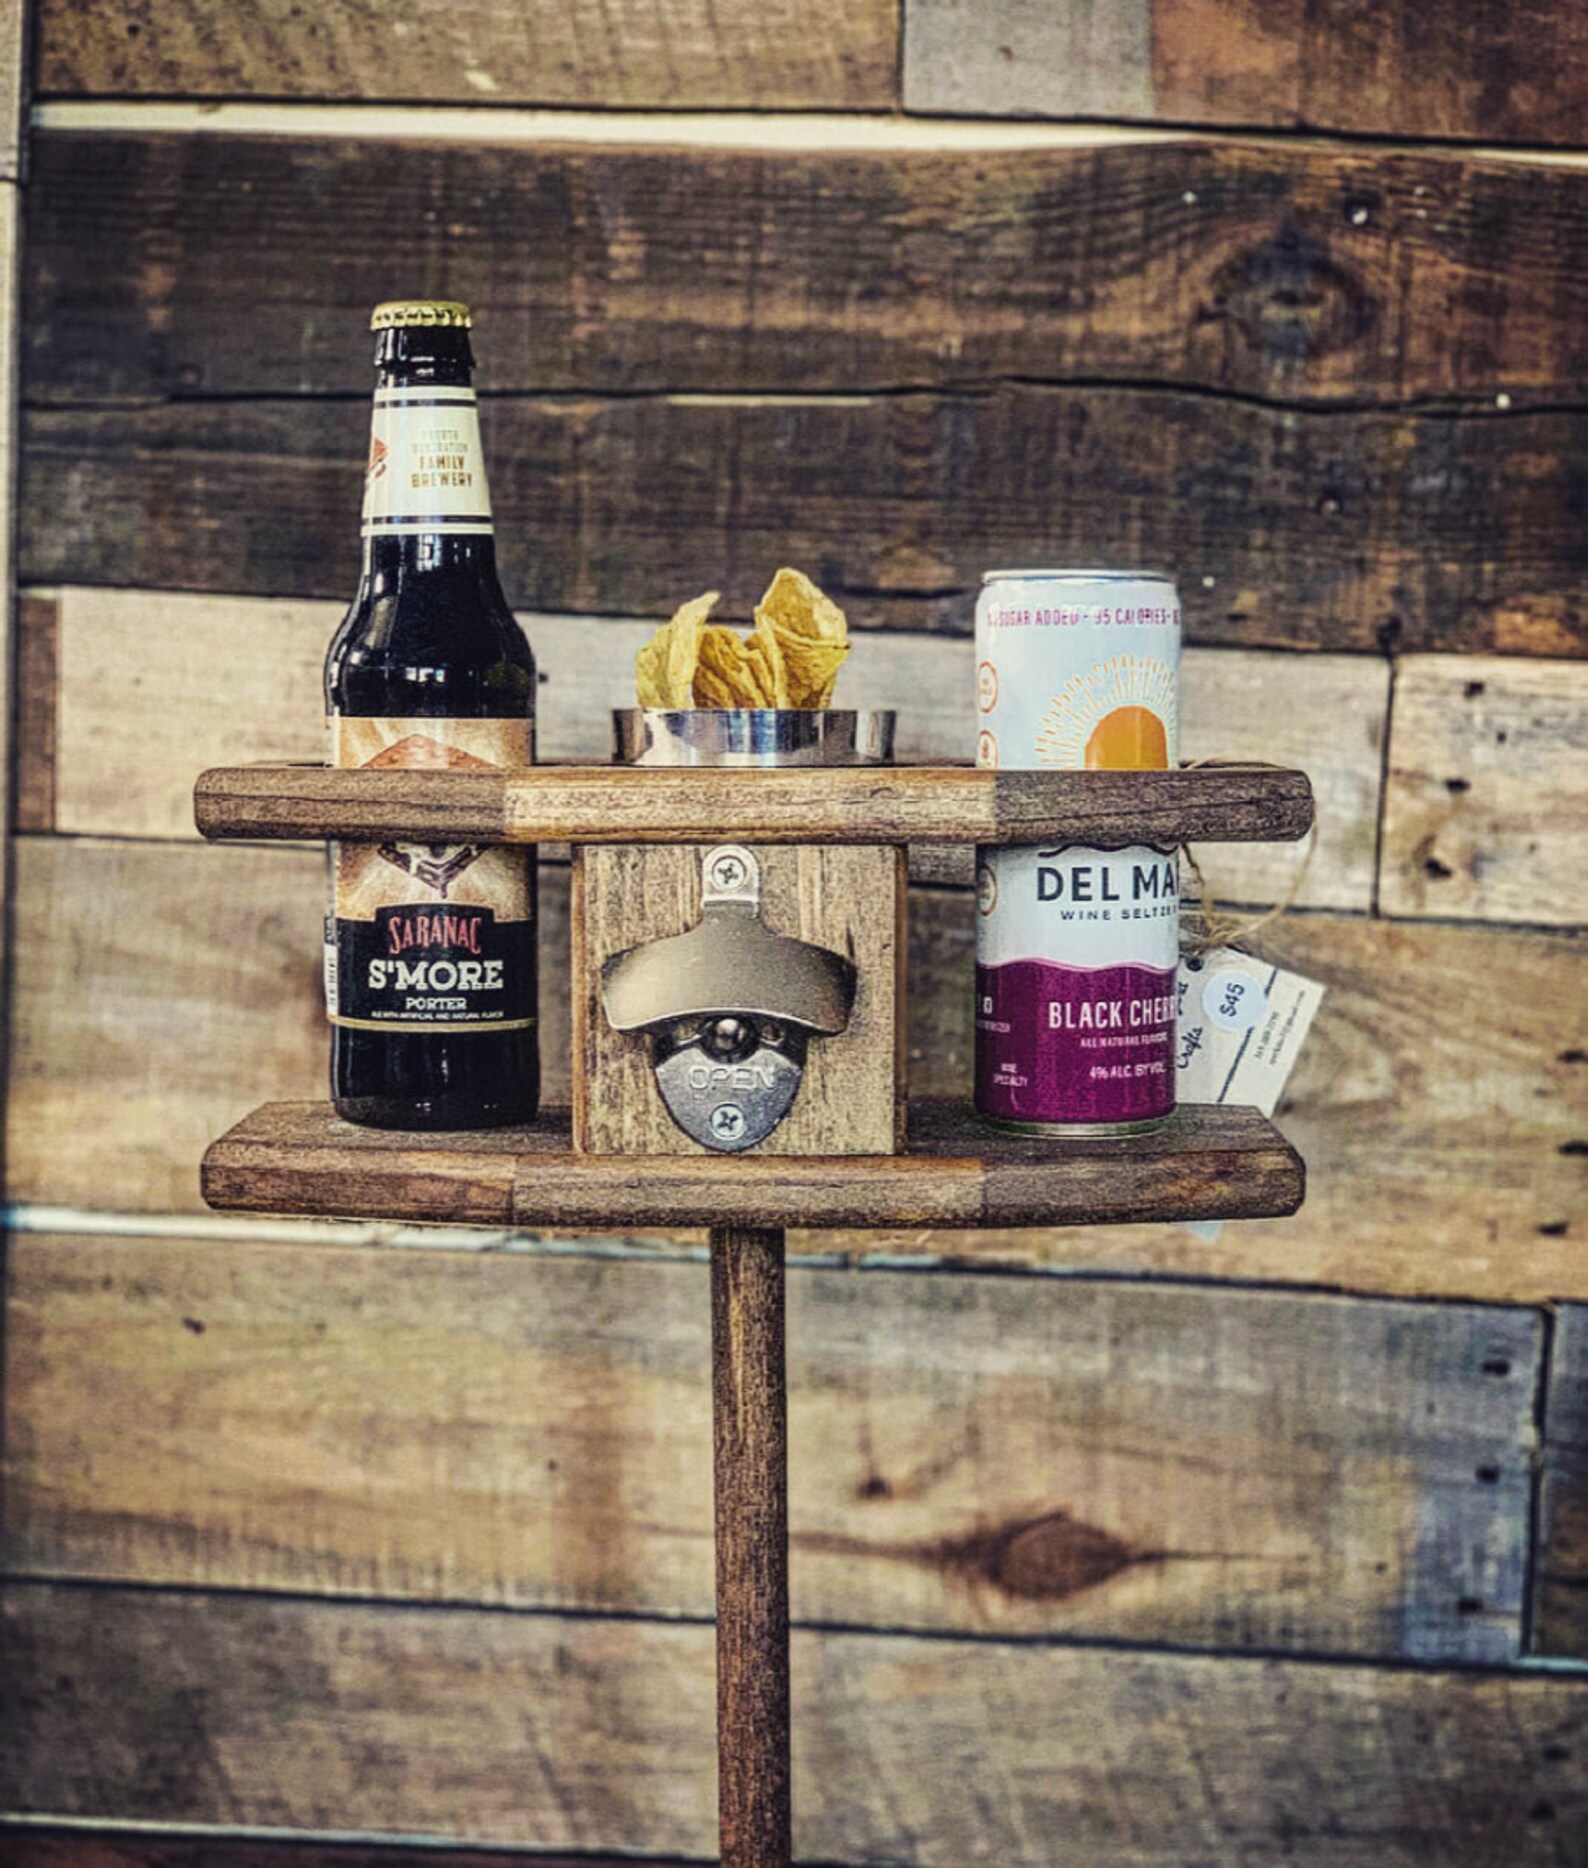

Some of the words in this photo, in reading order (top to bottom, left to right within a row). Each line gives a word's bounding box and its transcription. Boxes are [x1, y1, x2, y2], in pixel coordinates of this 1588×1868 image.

[419, 455, 465, 469] FAMILY
[411, 472, 473, 488] BREWERY
[1037, 866, 1120, 901] DEL
[1132, 862, 1180, 900] MA
[1060, 908, 1112, 921] WINE
[388, 914, 482, 954] SARANAC
[368, 957, 504, 990] S'MORE
[405, 997, 467, 1010] PORTER
[1048, 1001, 1123, 1029] BLACK
[1080, 1037, 1097, 1048] ALL
[1100, 1035, 1140, 1047] NATURAL
[1176, 1026, 1204, 1070] Crafts
[689, 1065, 777, 1091] OPEN
